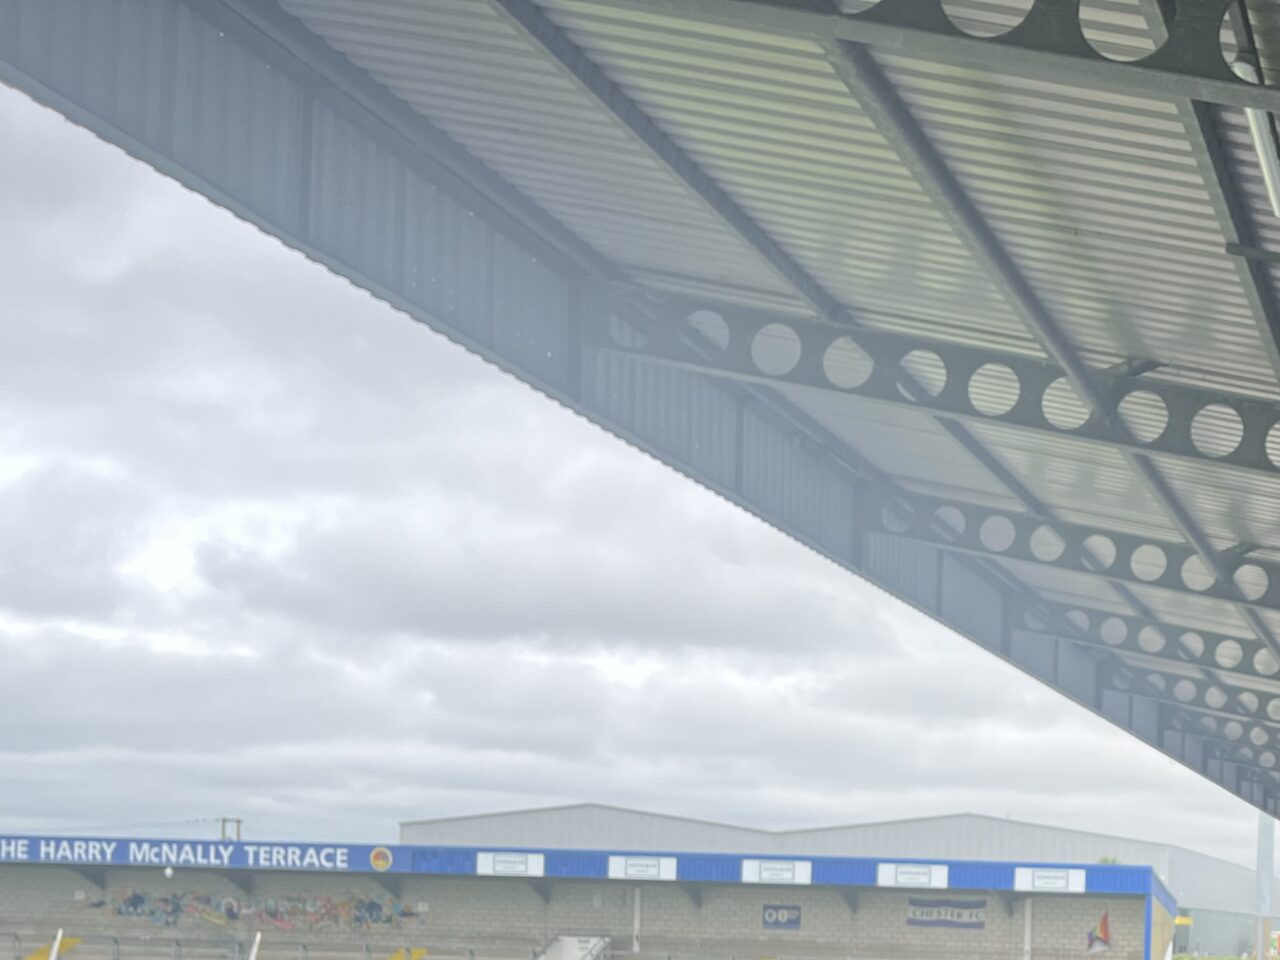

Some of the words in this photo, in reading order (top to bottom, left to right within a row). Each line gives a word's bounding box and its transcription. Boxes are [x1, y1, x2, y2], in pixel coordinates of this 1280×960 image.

[0, 839, 29, 860] HE
[40, 839, 117, 862] HARRY
[129, 841, 234, 865] McNALLY
[244, 845, 349, 869] TERRACE
[912, 908, 964, 920] CHESTER
